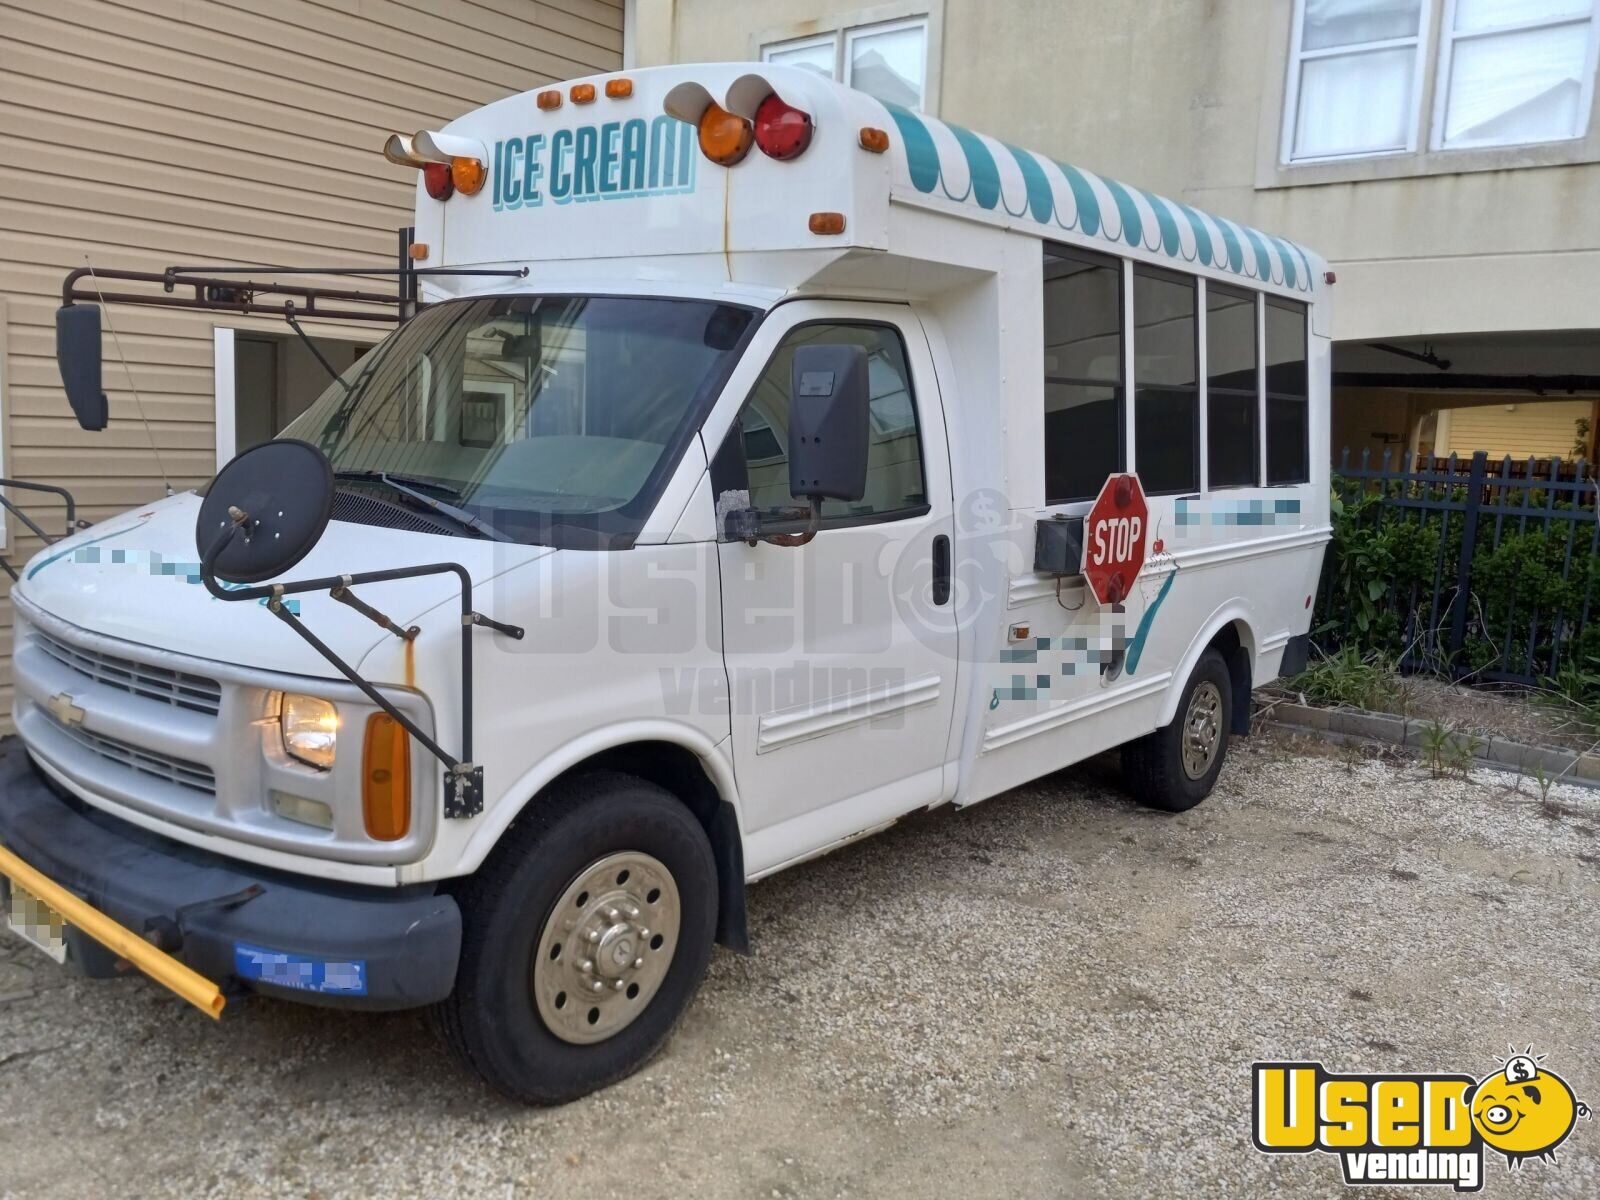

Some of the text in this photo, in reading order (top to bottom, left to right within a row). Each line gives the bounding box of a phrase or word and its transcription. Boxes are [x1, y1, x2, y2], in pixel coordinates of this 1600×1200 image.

[493, 115, 696, 211] ICE CREAM
[1093, 516, 1141, 565] STOP
